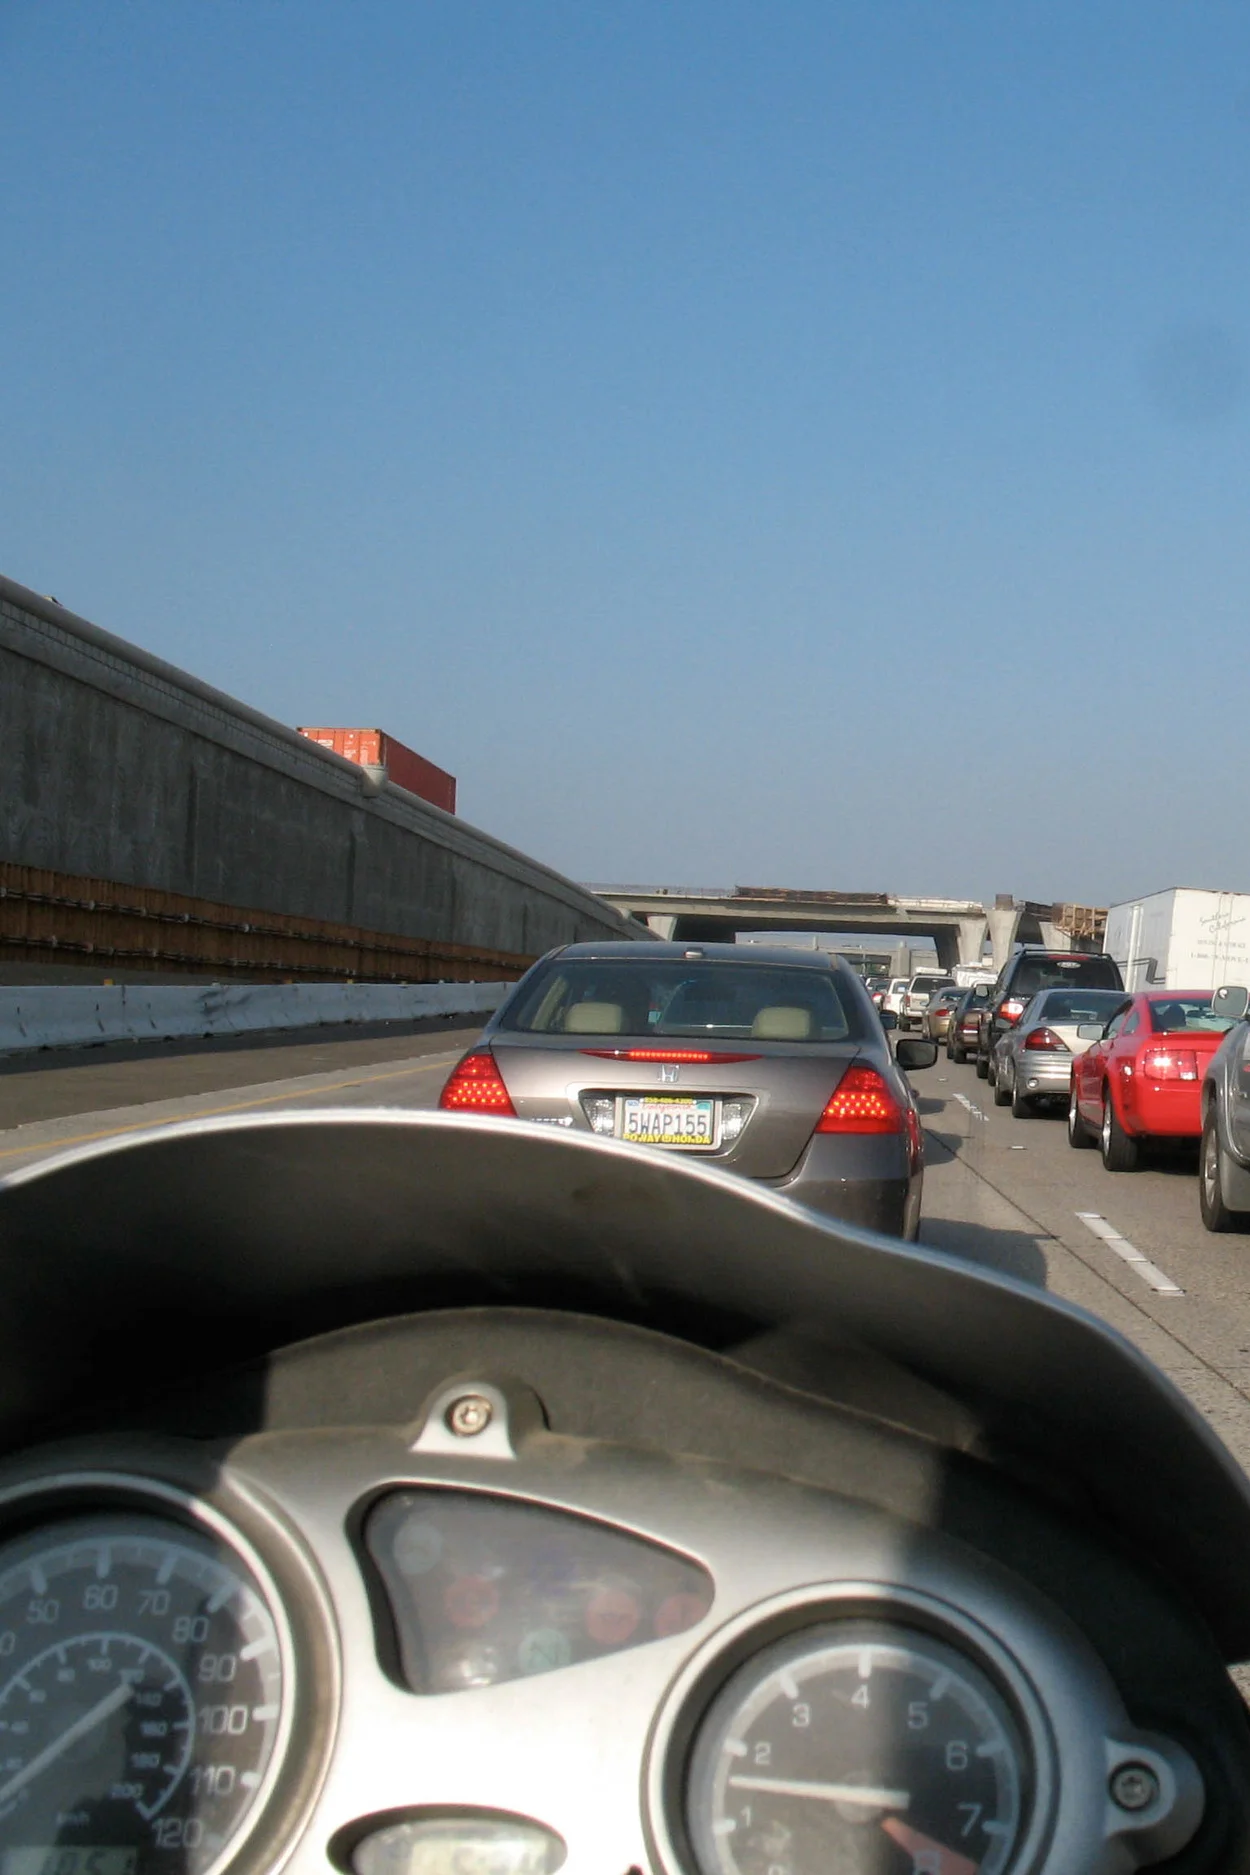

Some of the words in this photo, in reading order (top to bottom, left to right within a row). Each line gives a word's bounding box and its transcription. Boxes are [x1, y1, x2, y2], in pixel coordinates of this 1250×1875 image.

[628, 1112, 708, 1137] 5WAP155
[623, 1132, 662, 1143] POWAY
[672, 1133, 711, 1145] HONDA
[82, 1584, 119, 1610] 60
[137, 1589, 172, 1616] 70
[26, 1600, 60, 1625] 50
[171, 1615, 210, 1644] 80
[198, 1654, 237, 1683] 90
[850, 1683, 870, 1710] 4
[196, 1705, 249, 1736] 100
[791, 1703, 812, 1728] 3
[907, 1701, 930, 1730] 5
[753, 1742, 773, 1765] 2
[945, 1740, 969, 1771] 6
[188, 1765, 236, 1796] 110
[740, 1806, 752, 1829] 1
[957, 1802, 984, 1838] 7
[150, 1817, 203, 1849] 120
